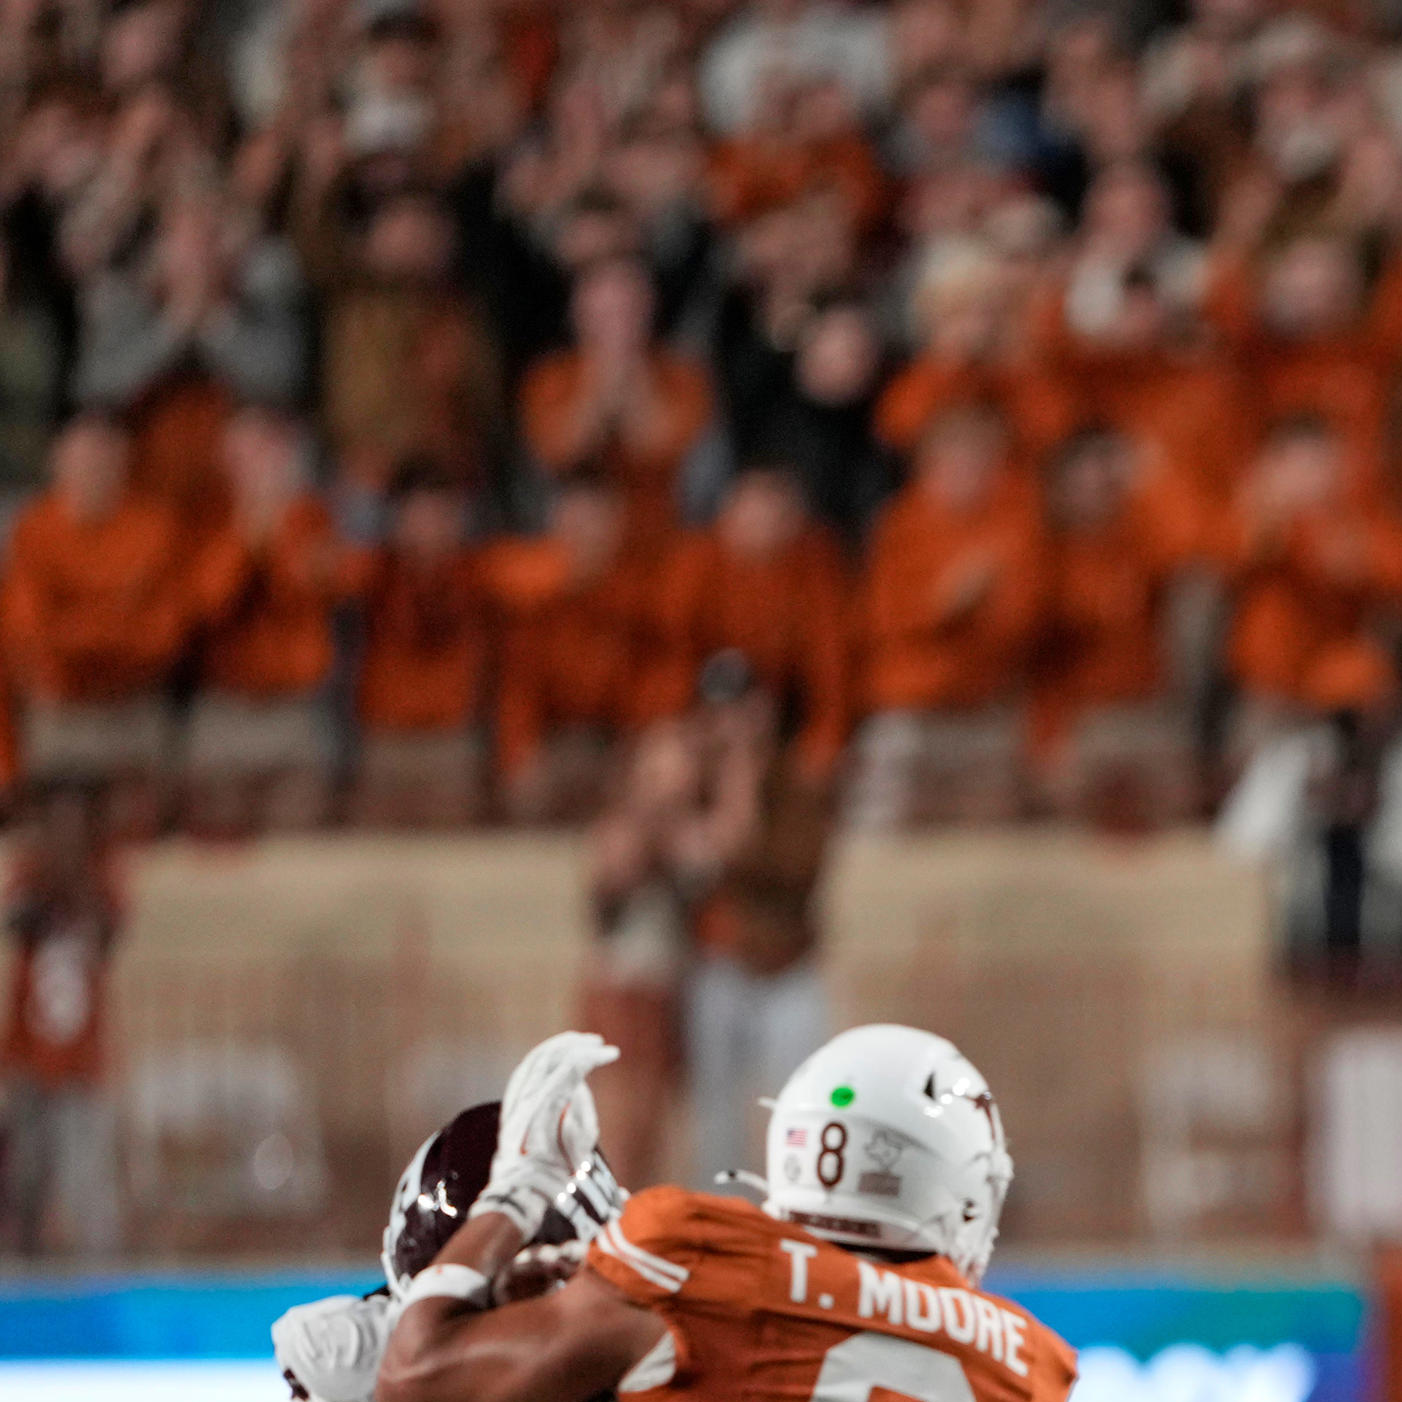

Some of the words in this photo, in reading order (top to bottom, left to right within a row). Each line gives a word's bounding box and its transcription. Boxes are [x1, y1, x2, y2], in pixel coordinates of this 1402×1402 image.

[817, 1122, 847, 1188] 8
[780, 1238, 835, 1310] T.
[857, 1260, 1029, 1377] MOORE
